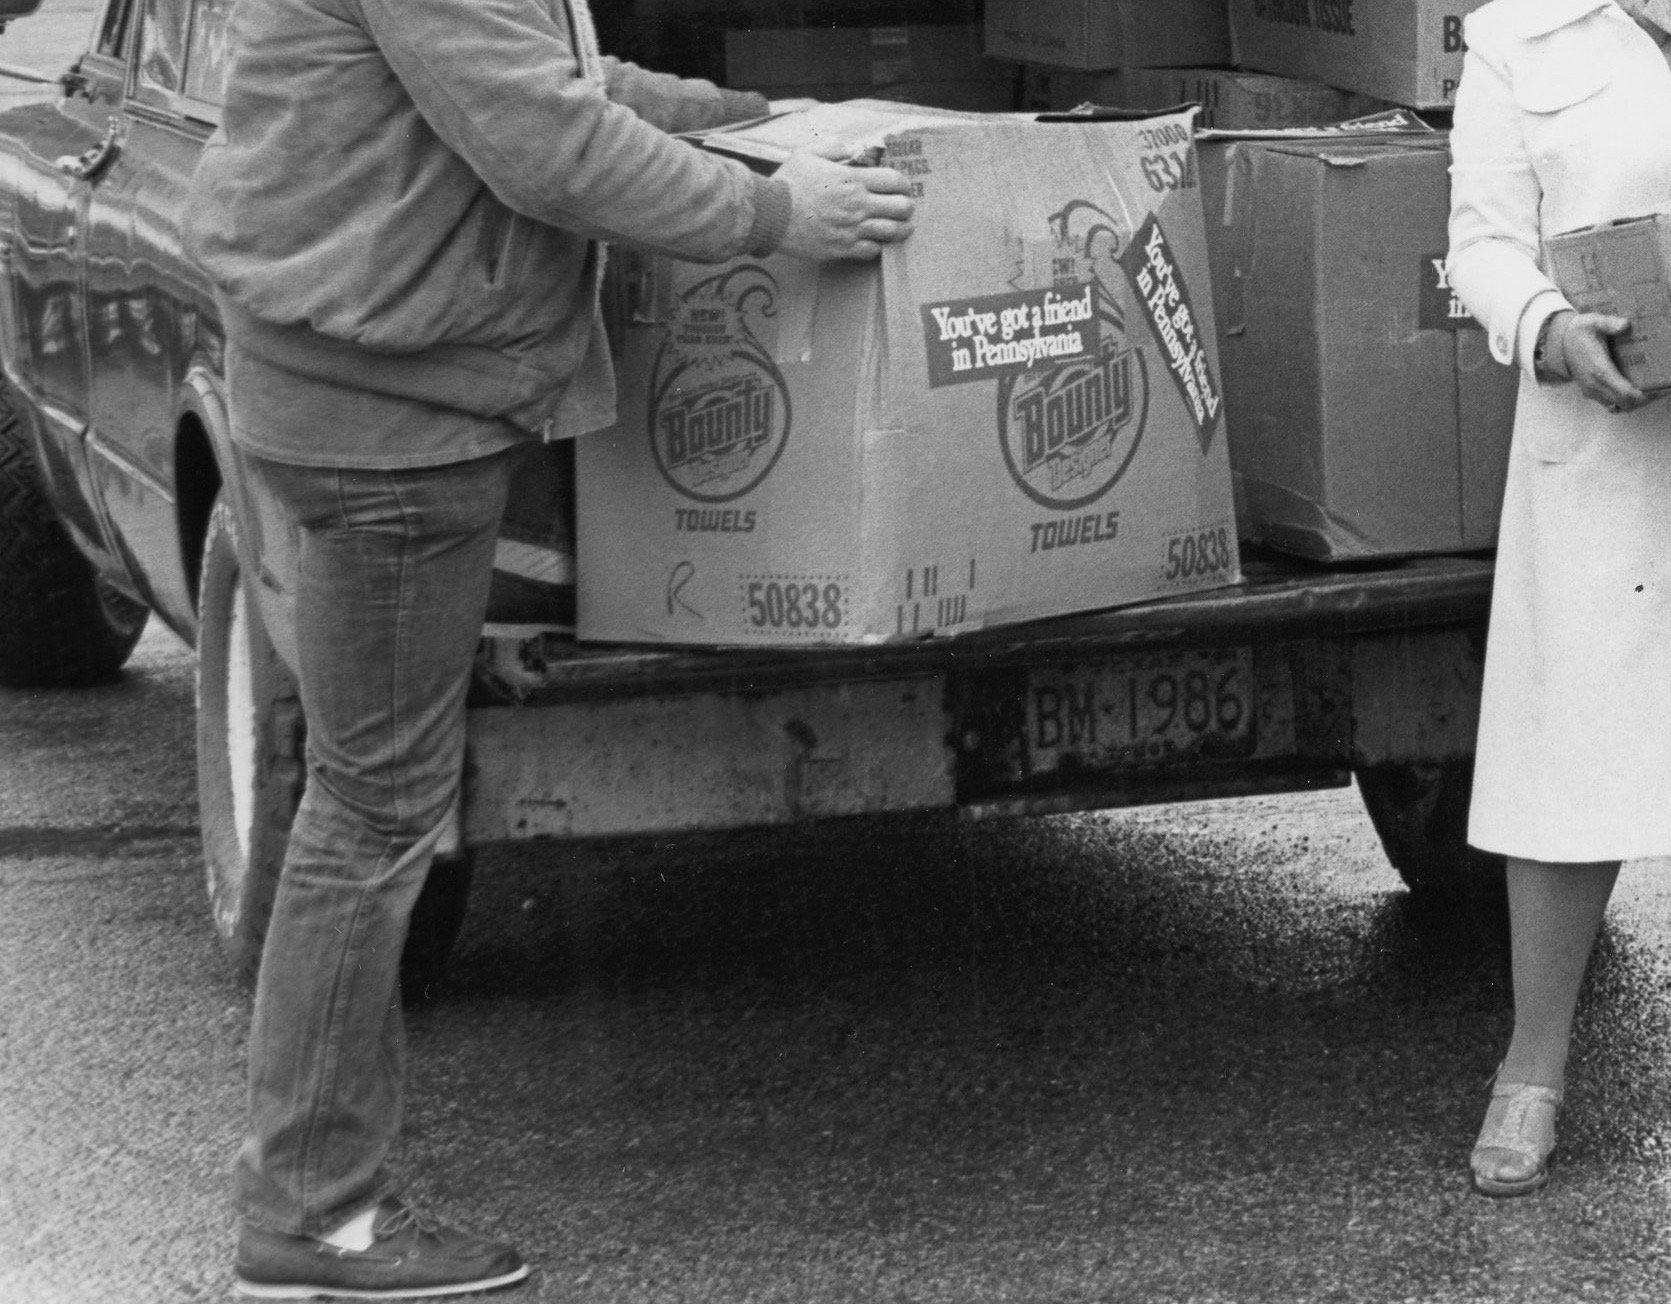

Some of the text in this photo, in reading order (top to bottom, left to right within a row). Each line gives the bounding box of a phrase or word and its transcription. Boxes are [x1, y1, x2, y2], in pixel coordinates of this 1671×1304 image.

[1138, 124, 1188, 149] 37000
[1145, 223, 1180, 307] You've
[931, 285, 1093, 340] You've got a friend
[952, 324, 1083, 371] in Pennsylvania
[1136, 262, 1205, 425] in Pennsylvania
[661, 378, 775, 469] Bounty
[1015, 337, 1133, 474] Bounty
[675, 508, 756, 532] TOWELS
[1030, 511, 1119, 553] TOWELS
[1166, 528, 1229, 580] 50838
[749, 582, 842, 628] 50838
